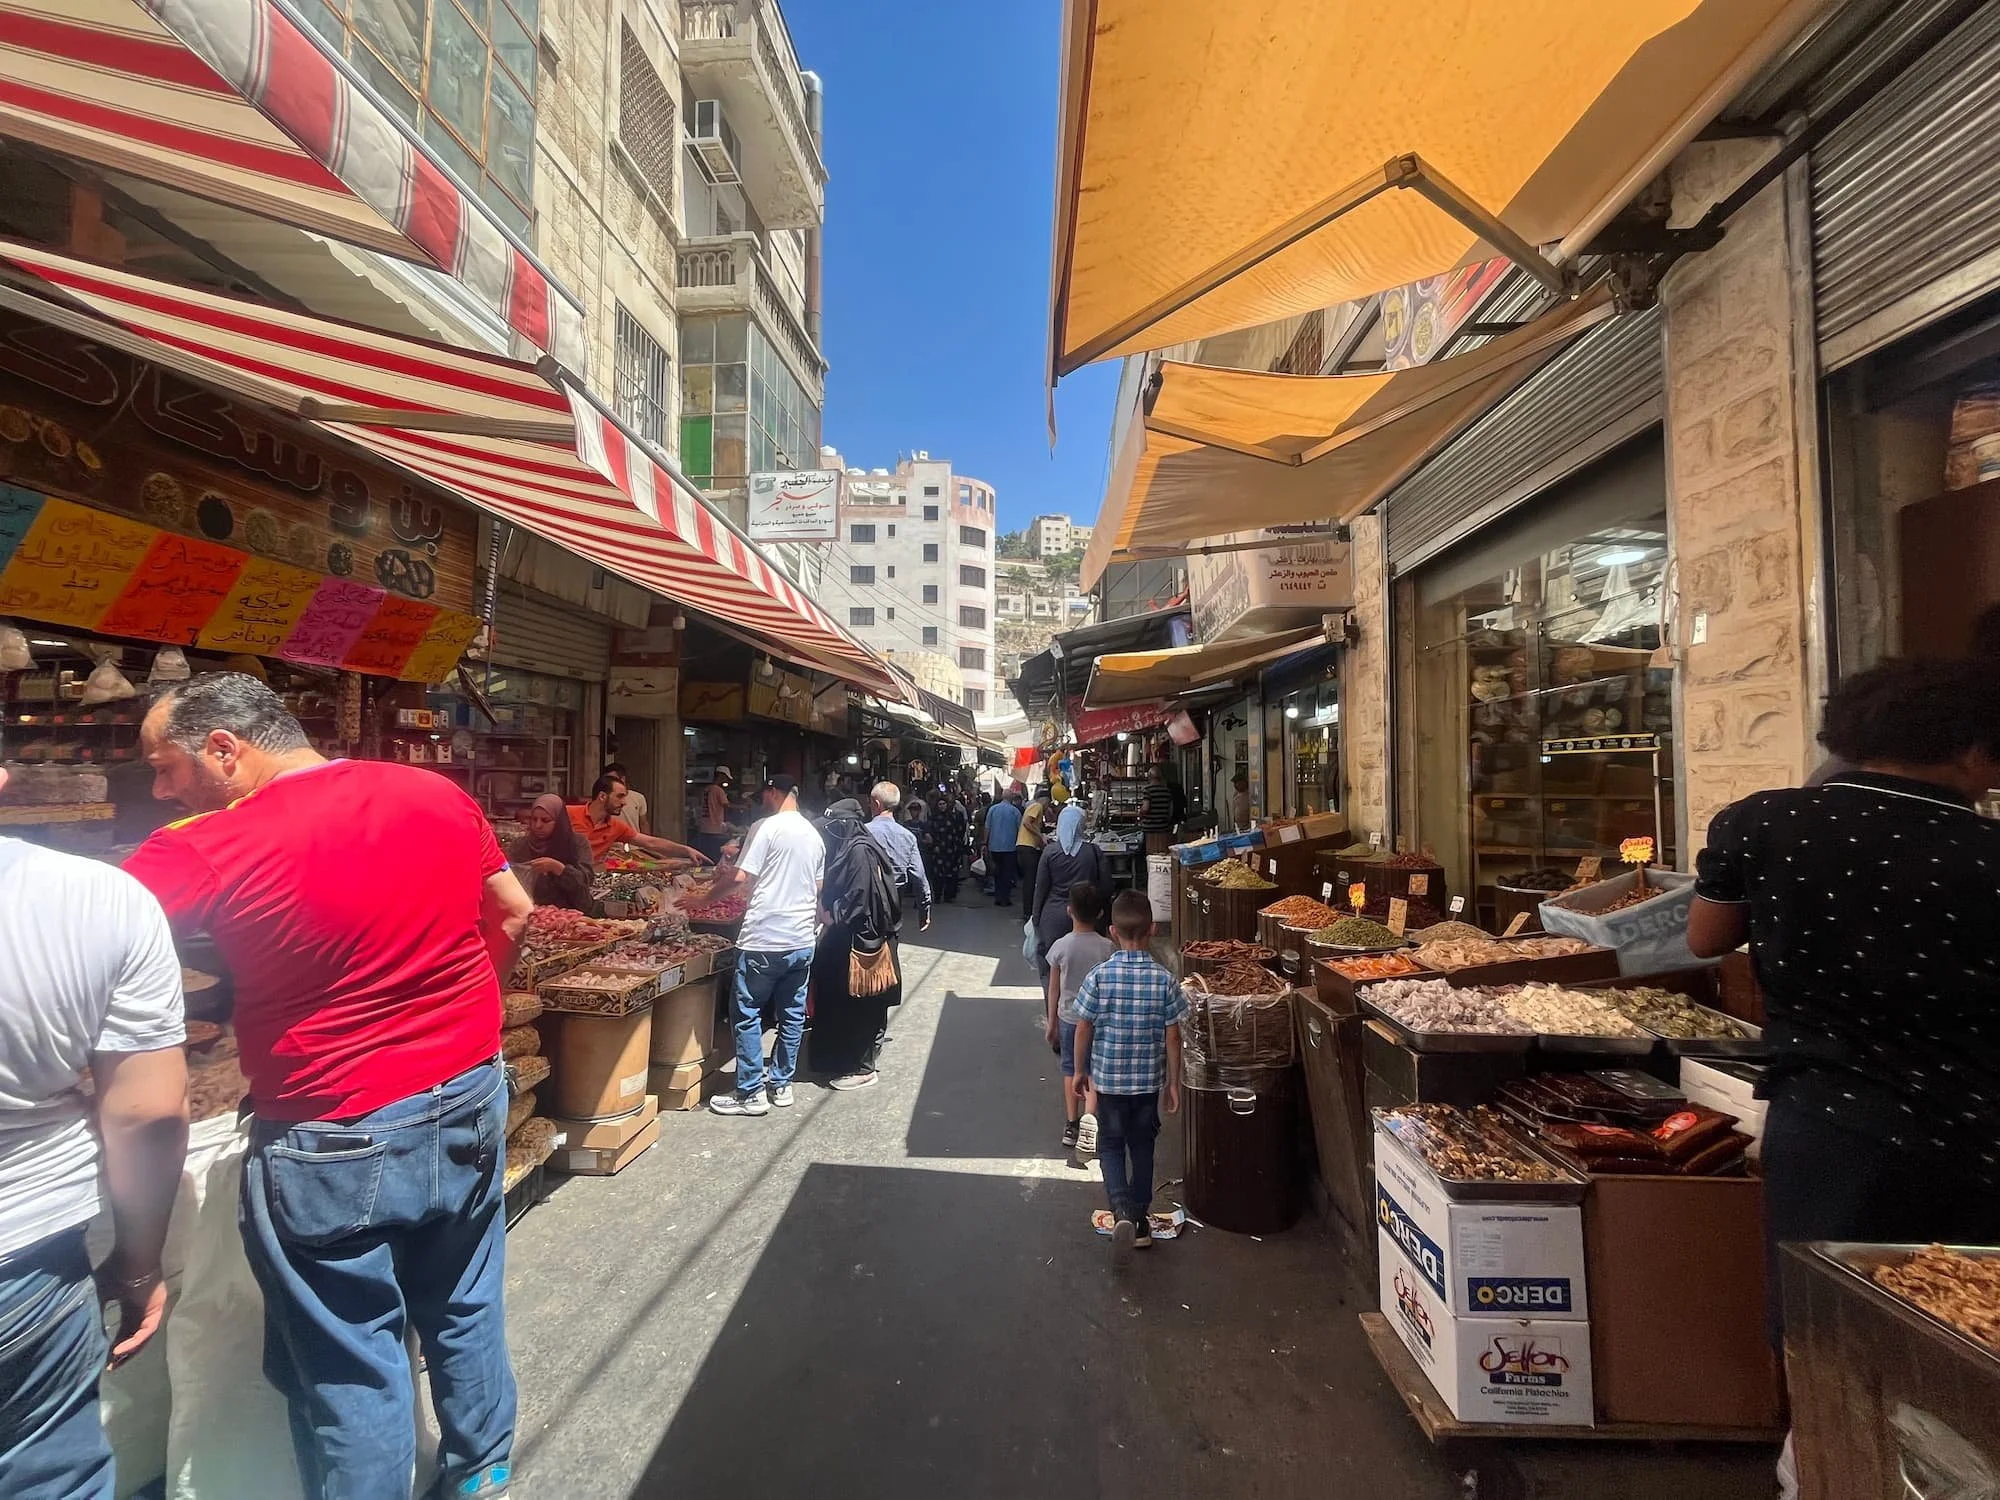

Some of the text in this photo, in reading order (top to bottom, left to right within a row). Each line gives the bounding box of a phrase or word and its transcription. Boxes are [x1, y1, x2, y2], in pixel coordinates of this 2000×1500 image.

[389, 484, 443, 557] بن
[1619, 903, 1689, 945] DERC
[1379, 1199, 1438, 1284] DERCO
[1477, 1285, 1563, 1305] DERCO
[1480, 1385, 1570, 1398] California Pistachios
[1504, 1373, 1546, 1385] Farms
